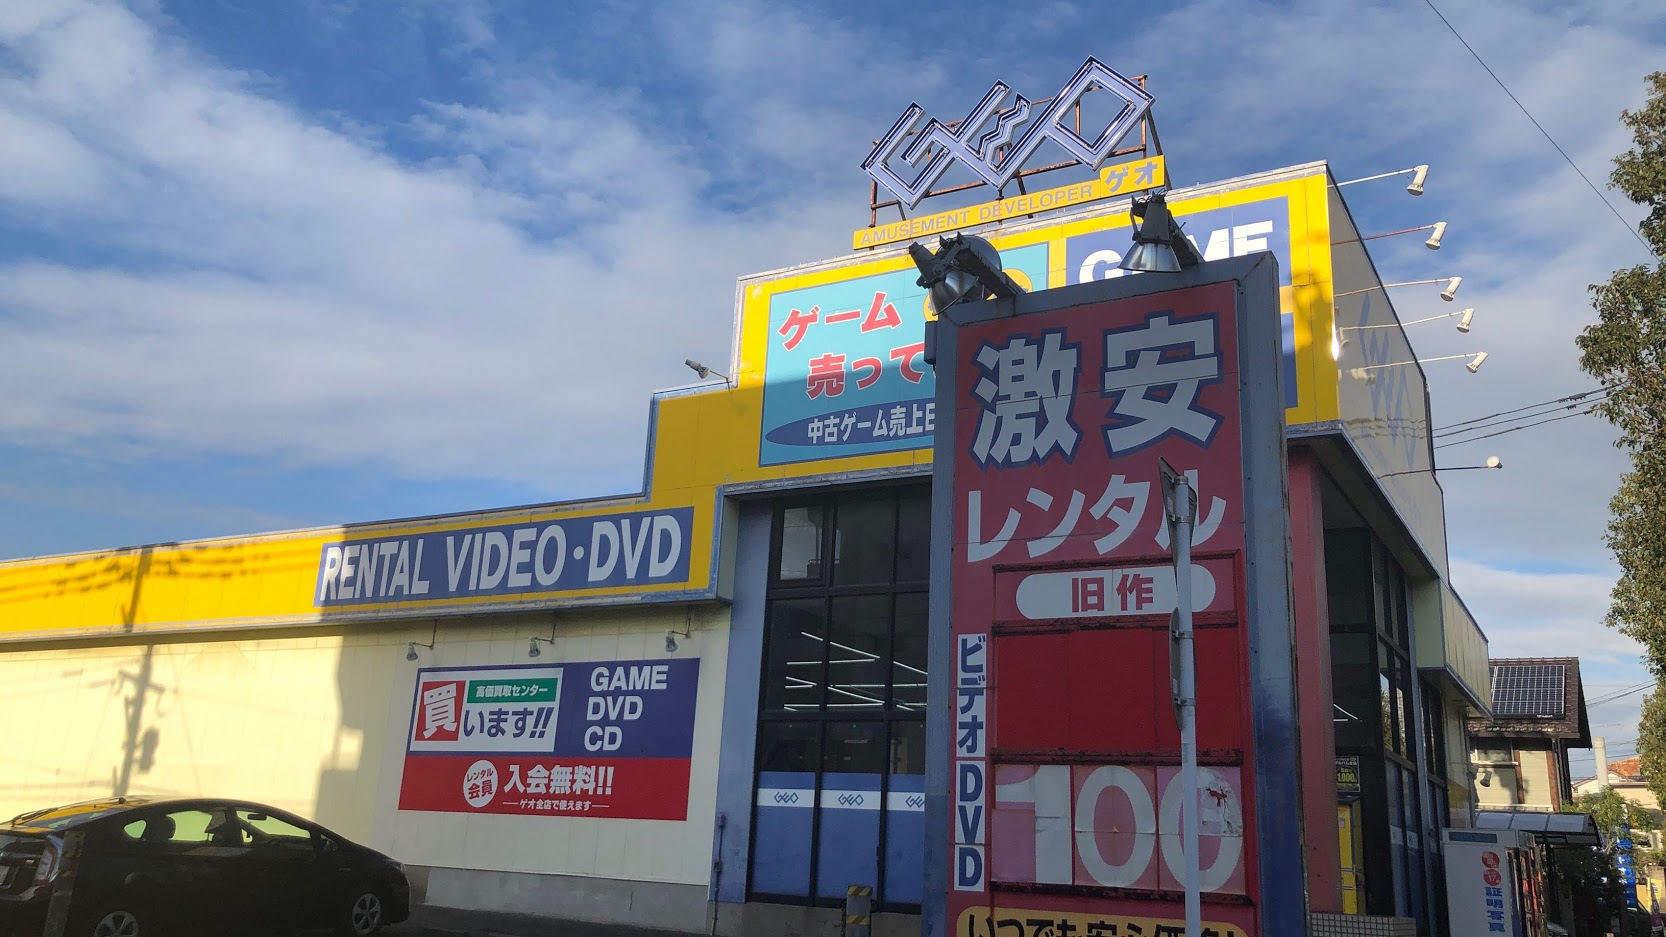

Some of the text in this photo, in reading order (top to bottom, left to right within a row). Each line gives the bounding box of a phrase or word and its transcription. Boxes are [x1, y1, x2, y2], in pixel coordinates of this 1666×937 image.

[1105, 161, 1159, 193] ゲオ
[860, 185, 1093, 245] AMUSEMENT DEVELOPER
[1079, 220, 1273, 284] GME
[777, 291, 903, 351] ゲーム
[806, 342, 936, 400] 売って
[971, 312, 1223, 468] 激安
[968, 469, 1227, 562] レンタル
[320, 538, 430, 601] RENTAL
[1071, 573, 1154, 613] 旧作
[476, 684, 548, 698] 高価買取センター
[590, 665, 669, 692] GAME
[586, 695, 643, 720] DVD
[584, 725, 623, 751] CD
[466, 768, 494, 782] レンタル
[957, 635, 986, 887] ビデオ DVD
[468, 779, 493, 800] 会員
[503, 764, 615, 795] 入会無料!!
[519, 798, 592, 811] ゲオ全店で使えます
[905, 795, 925, 808] GE
